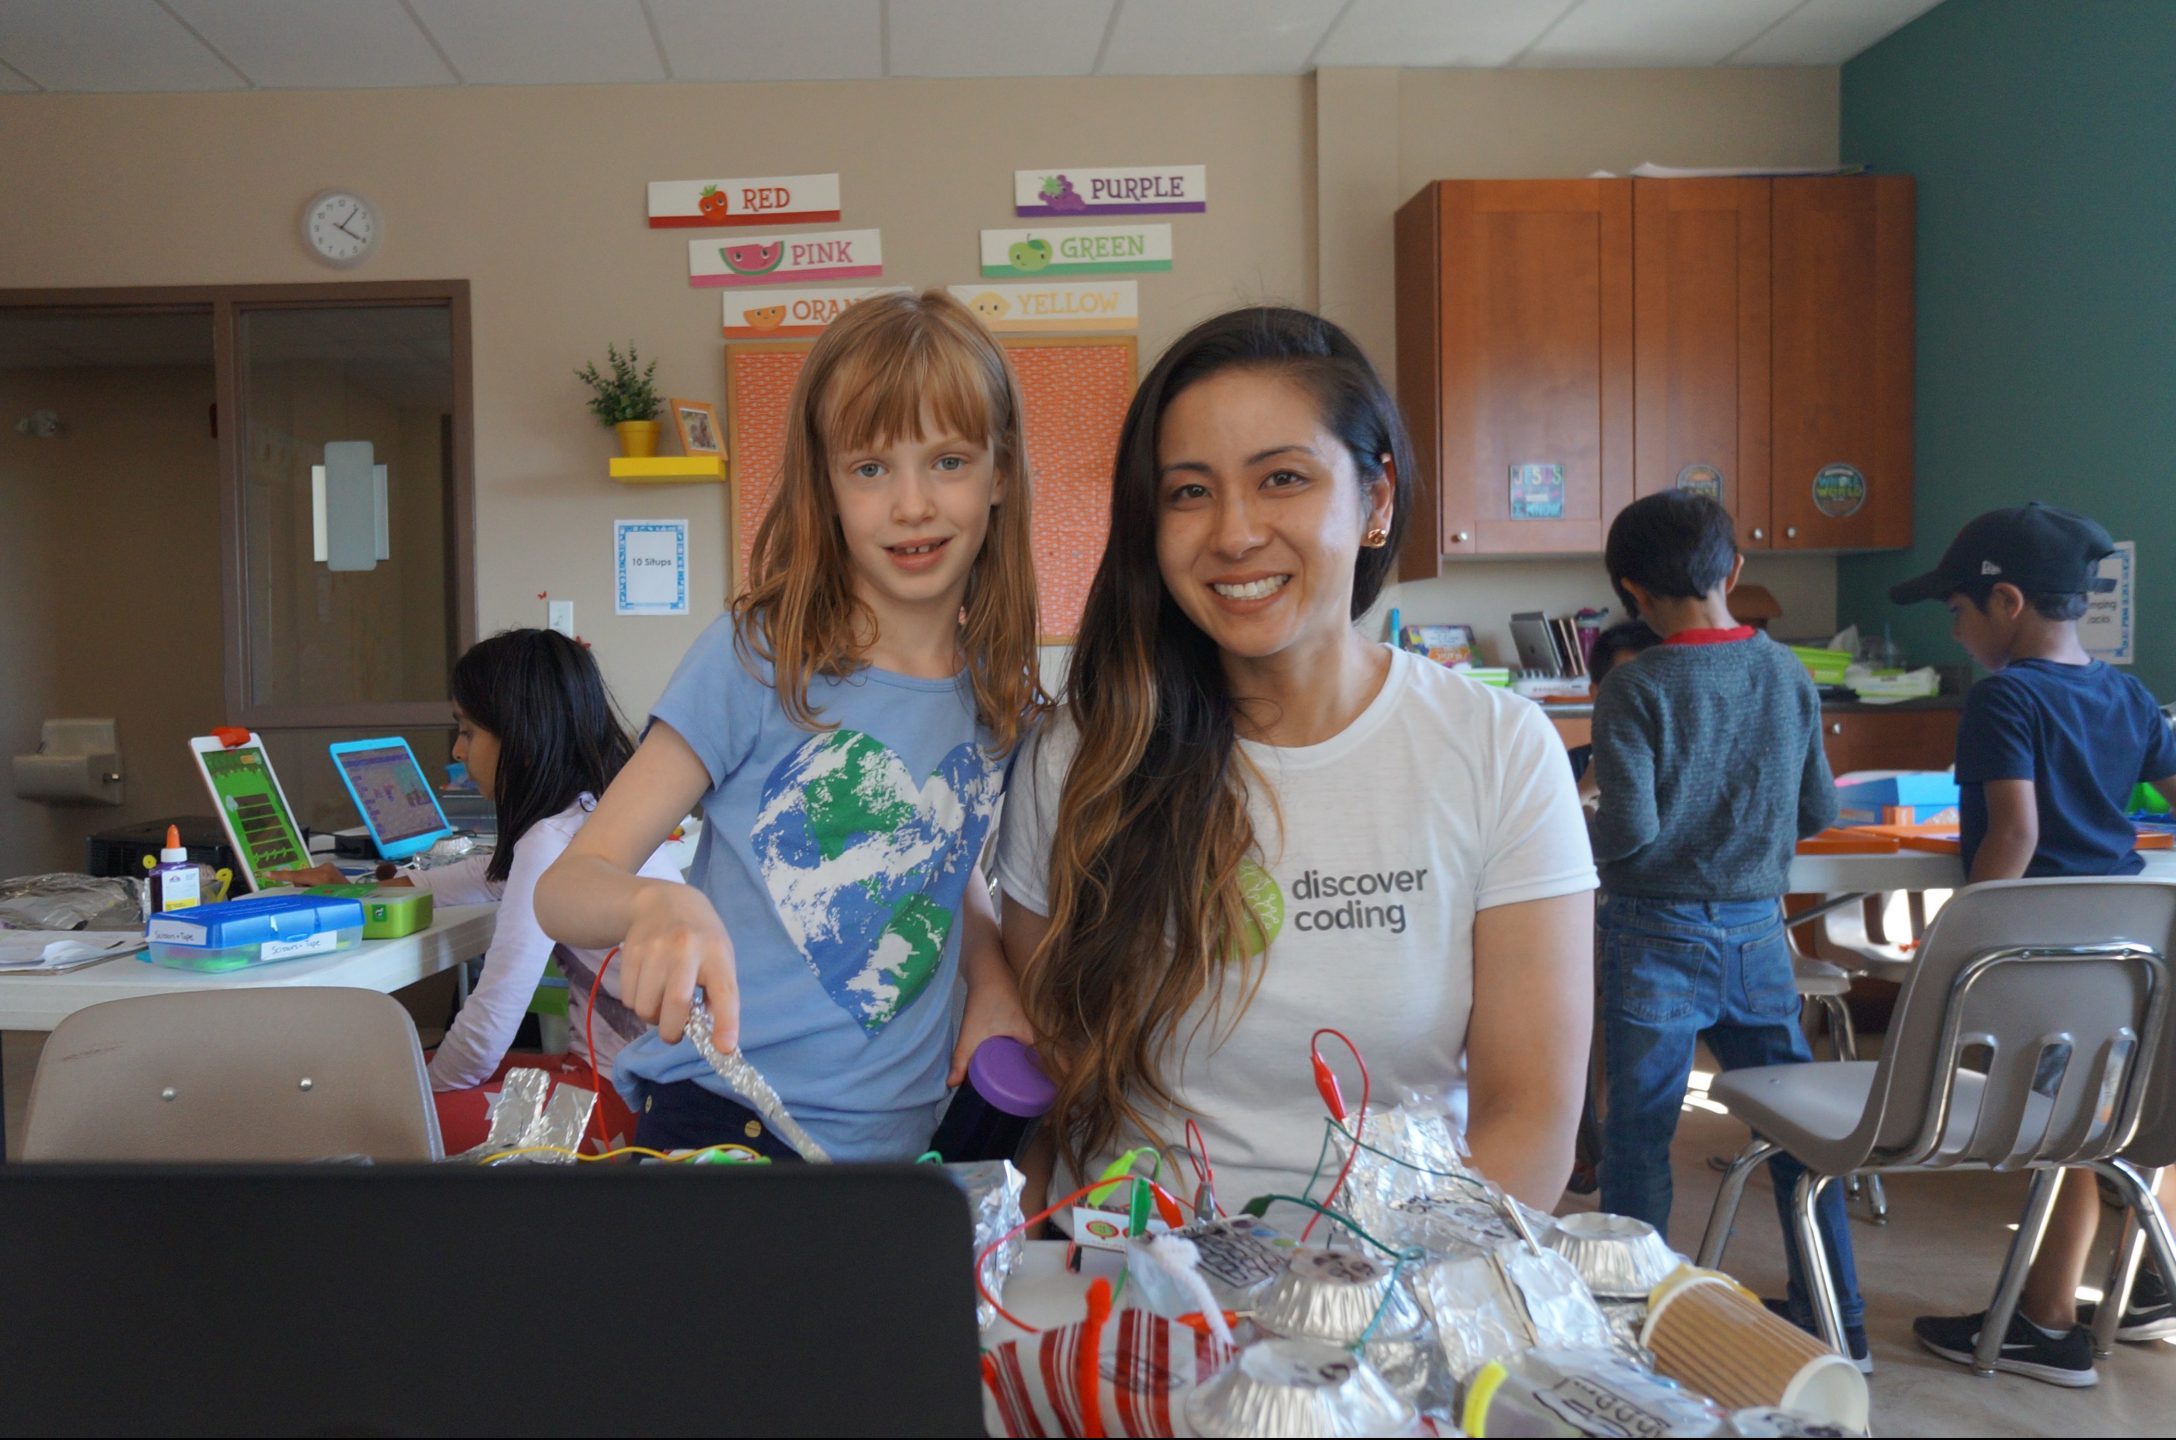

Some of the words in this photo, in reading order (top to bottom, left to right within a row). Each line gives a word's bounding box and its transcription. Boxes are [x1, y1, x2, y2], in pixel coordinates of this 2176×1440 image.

[742, 187, 790, 212] RED
[1091, 176, 1184, 201] PURPLE
[790, 241, 854, 266] PINK
[1060, 235, 1145, 260] GREEN
[1018, 290, 1120, 314] YELLOW
[632, 558, 642, 566] 10
[1291, 869, 1428, 900] discover
[1294, 900, 1407, 934] coding
